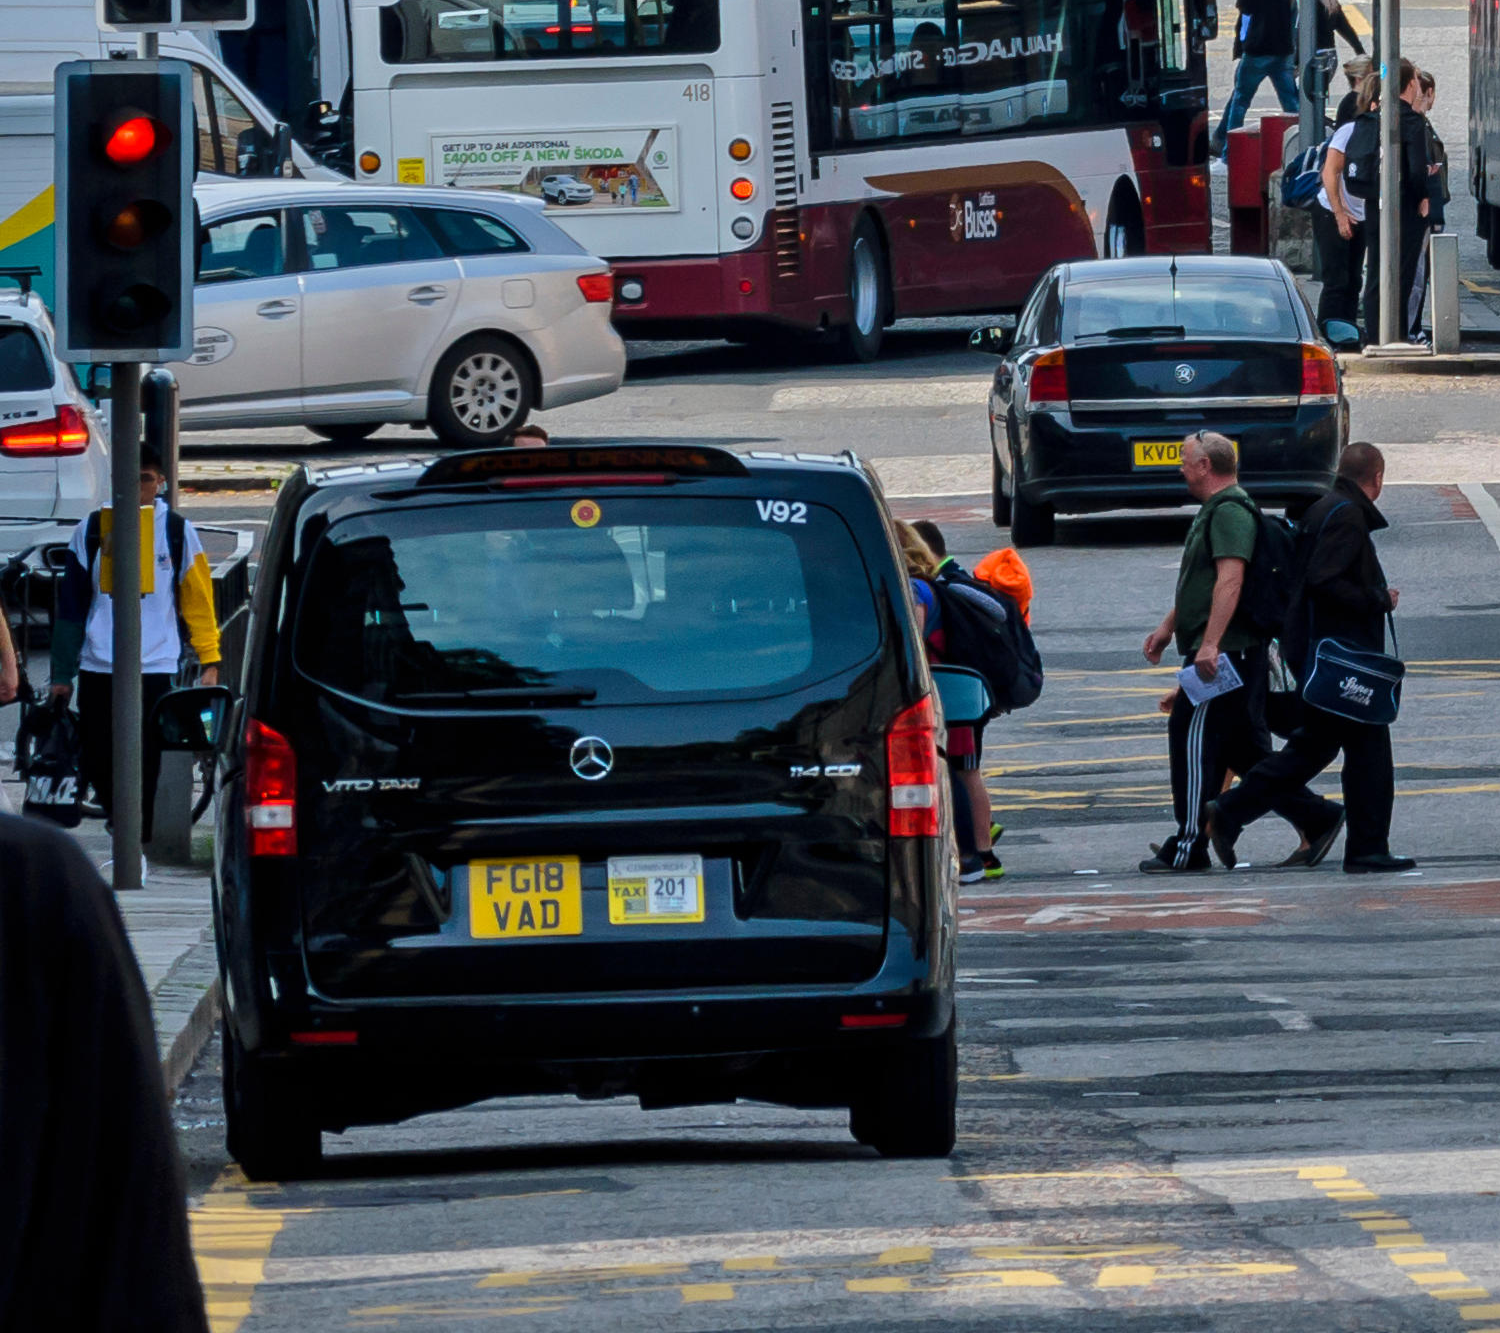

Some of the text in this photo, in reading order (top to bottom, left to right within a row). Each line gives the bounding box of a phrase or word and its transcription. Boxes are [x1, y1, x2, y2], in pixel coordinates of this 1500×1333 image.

[682, 83, 711, 102] 418
[442, 140, 571, 153] GET UP TO AN ADDITIONAL
[443, 145, 624, 165] £4000 OFF A NEW ŠKODA
[964, 200, 997, 240] Buses
[755, 499, 808, 524] V92
[824, 765, 862, 777] CDI
[322, 777, 421, 792] VITO TAXI
[485, 862, 565, 896] FG18
[654, 877, 686, 897] 201
[613, 886, 646, 898] TAXI
[492, 898, 561, 932] VAD
